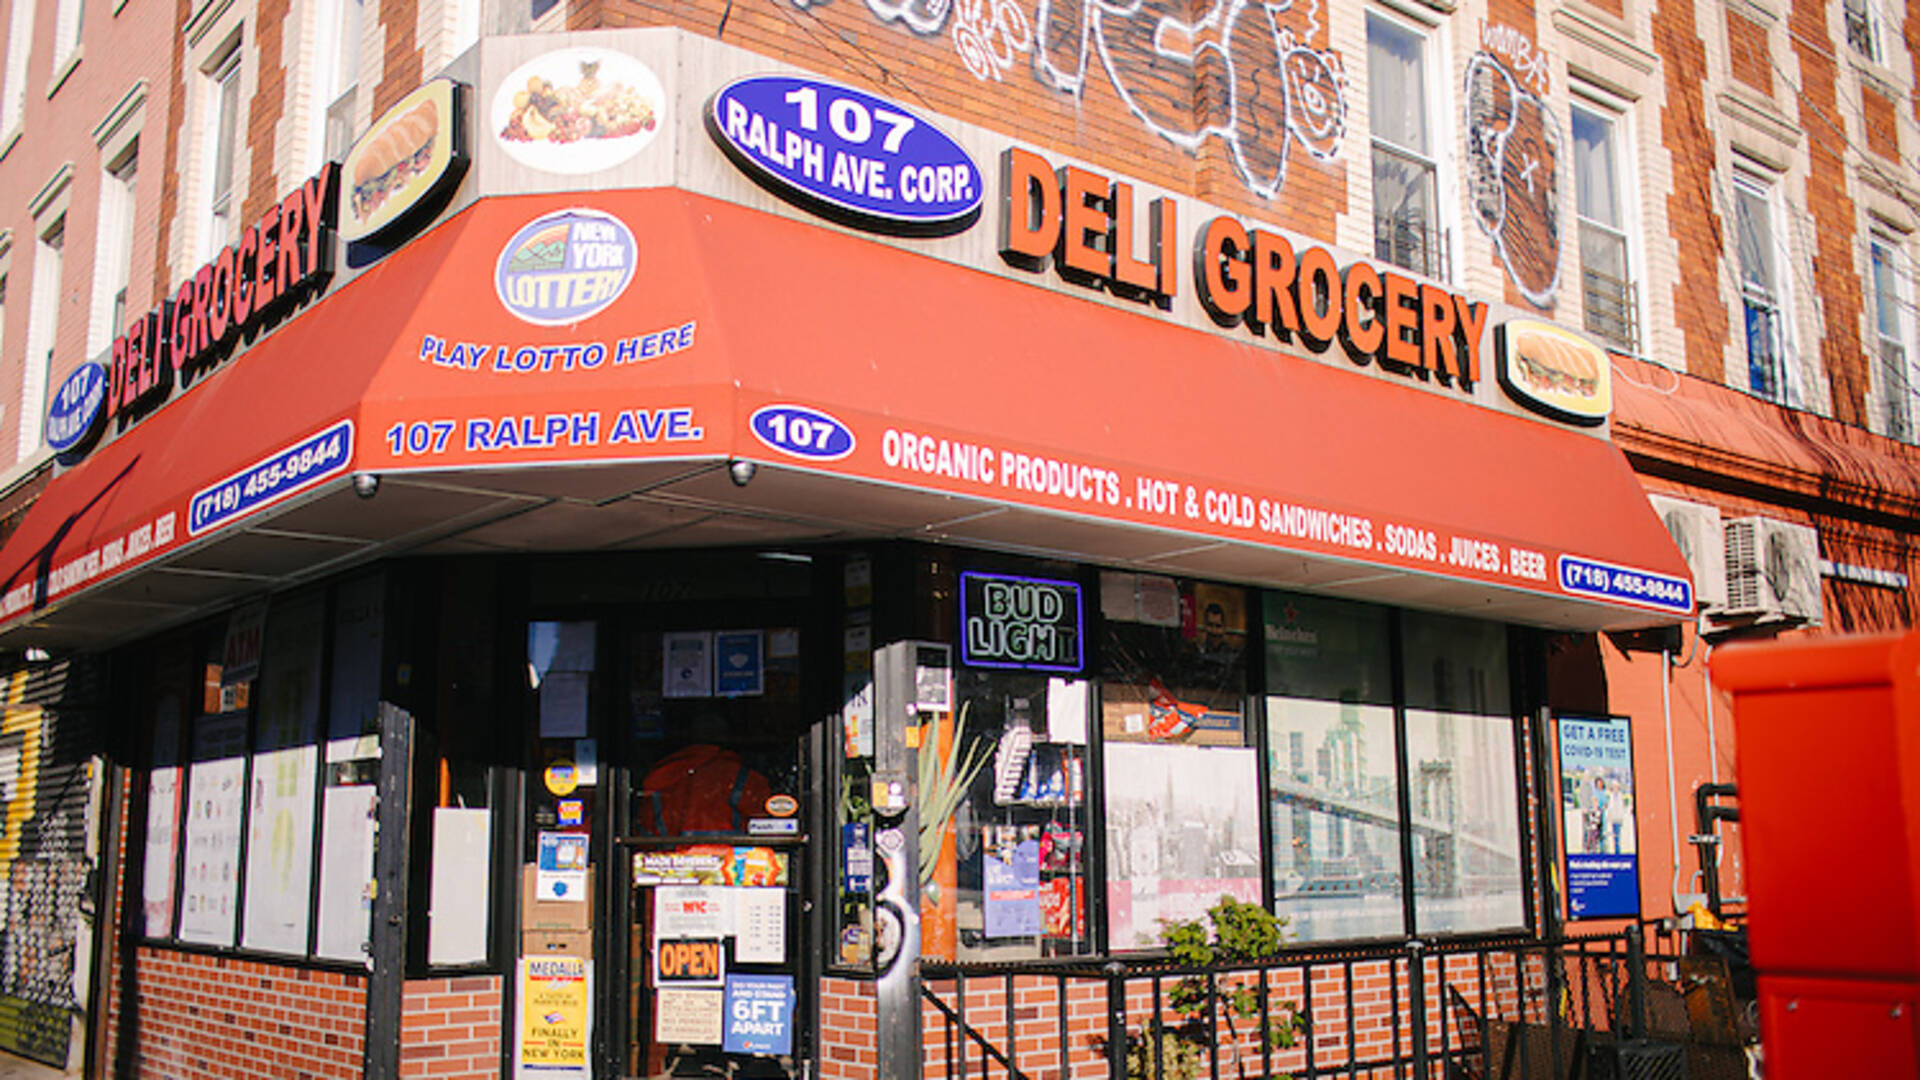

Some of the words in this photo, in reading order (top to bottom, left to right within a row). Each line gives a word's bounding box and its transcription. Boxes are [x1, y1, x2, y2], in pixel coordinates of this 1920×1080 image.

[785, 86, 915, 154] 107
[726, 97, 825, 183] RALPH
[831, 151, 893, 200] AVE.
[900, 164, 973, 203] CORP.
[572, 221, 617, 242] NEW
[572, 242, 626, 269] YORK
[1002, 146, 1177, 302] DELI
[1199, 215, 1488, 384] GROCERY
[106, 299, 166, 420] DELI
[171, 162, 331, 371] GROCERY
[506, 268, 627, 309] LOTTERY
[420, 335, 489, 371] PLAY
[494, 343, 606, 371] LOTTO
[613, 321, 695, 365] HERE
[61, 364, 92, 412] 107
[386, 422, 454, 455] 107
[466, 413, 600, 451] RALPH
[609, 408, 703, 444] AVE.
[767, 414, 835, 450] 107
[195, 482, 241, 526] (718)
[243, 433, 341, 497] 455-9844
[882, 429, 994, 484] ORGANIC
[1001, 450, 1120, 506] PRODUCTS
[1137, 477, 1179, 515] HOT
[1184, 485, 1200, 518] &
[1204, 489, 1255, 528] COLD
[1259, 499, 1373, 549] SANDWICHES
[1385, 524, 1437, 562] SODAS
[1448, 536, 1501, 573] JUICES
[1510, 548, 1547, 581] BEER
[1566, 563, 1610, 592] (718)
[1612, 573, 1684, 602] 455-9844
[984, 583, 1063, 622] BUD
[968, 617, 1078, 662] LIGHT
[1563, 724, 1584, 740] GET
[1587, 727, 1595, 740] A
[1598, 727, 1625, 743] FREE
[530, 962, 585, 976] MEDALLA
[660, 943, 718, 976] OPEN
[731, 1021, 784, 1036] APART
[733, 999, 786, 1022] 6FT
[531, 1027, 578, 1039] FINALLY
[523, 1048, 549, 1058] NEW
[553, 1049, 585, 1059] YORK
